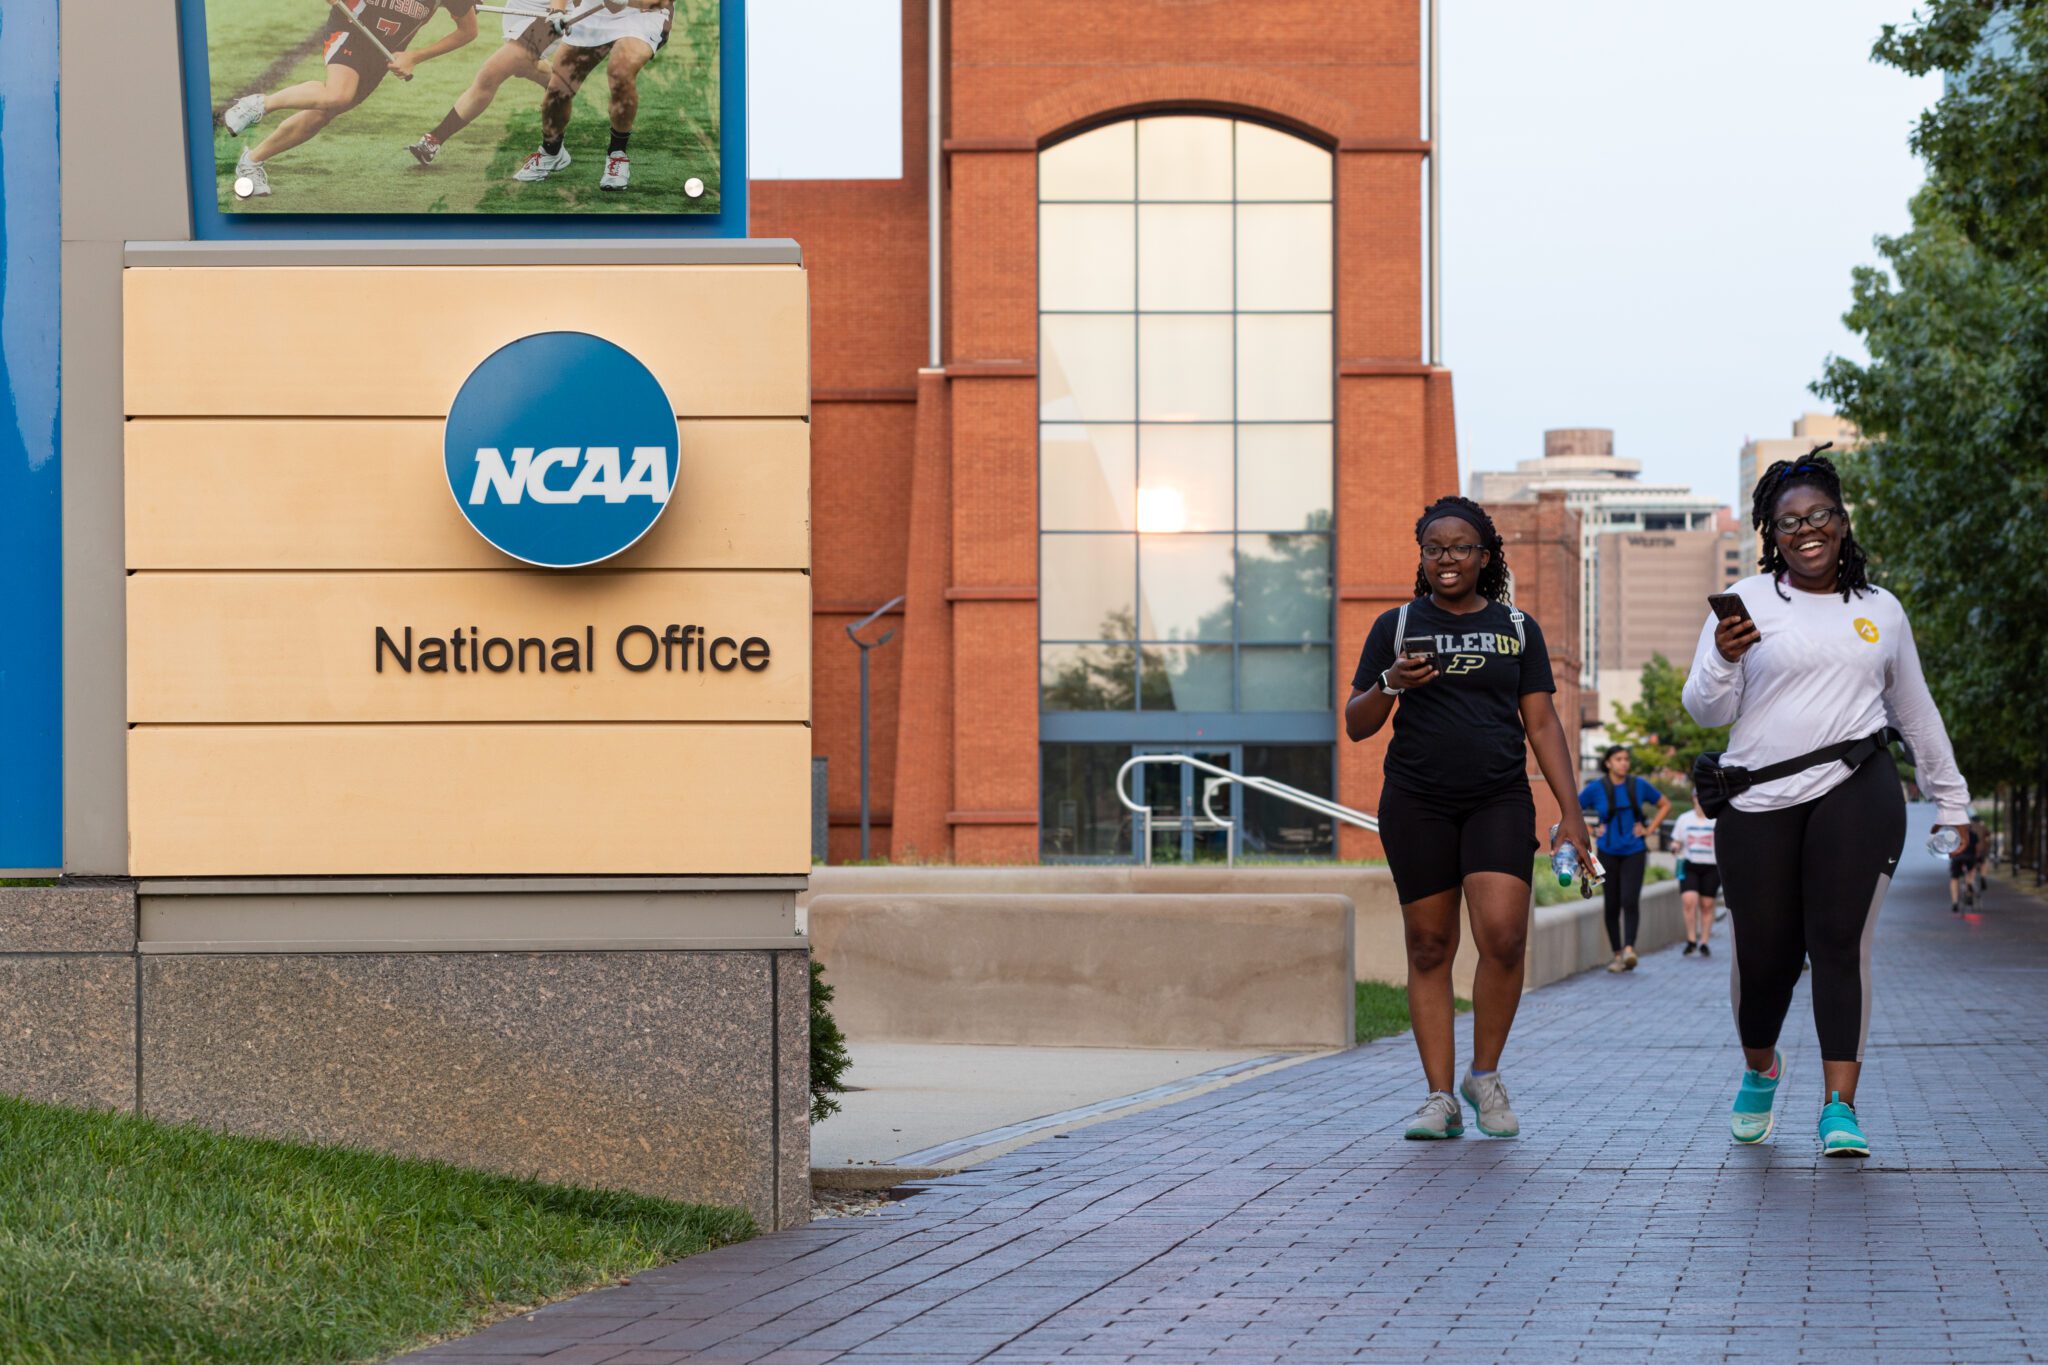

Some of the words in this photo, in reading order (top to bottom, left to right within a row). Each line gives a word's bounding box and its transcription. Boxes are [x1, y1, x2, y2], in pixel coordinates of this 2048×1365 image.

[376, 17, 401, 36] 7
[469, 447, 670, 505] NCAA
[375, 626, 594, 674] National
[616, 625, 771, 673] Office
[1434, 633, 1520, 656] ILERUP
[1446, 654, 1486, 675] P
